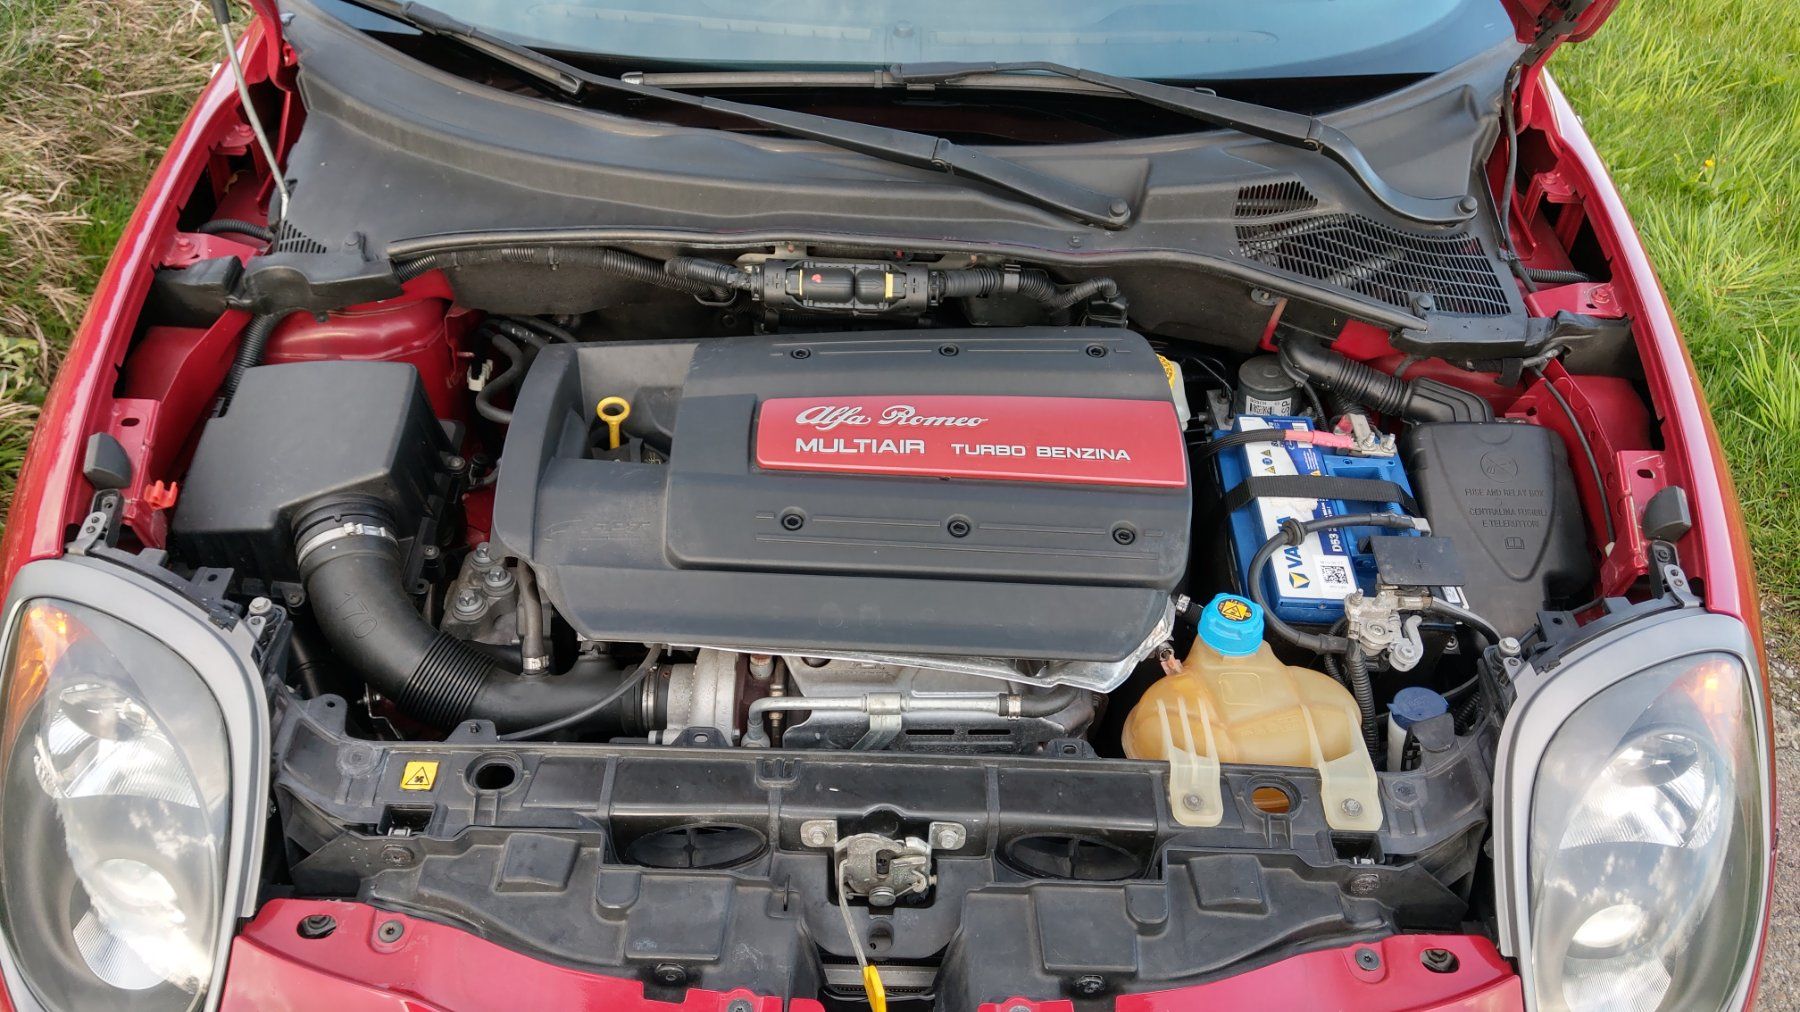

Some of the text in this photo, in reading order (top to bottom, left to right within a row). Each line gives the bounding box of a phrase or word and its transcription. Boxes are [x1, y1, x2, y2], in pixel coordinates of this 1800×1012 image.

[795, 405, 989, 430] Alfa Romeo
[795, 438, 1131, 462] MULTIAIR TURBO BENZINA
[1464, 488, 1544, 497] FUSE AND RELAY BOX
